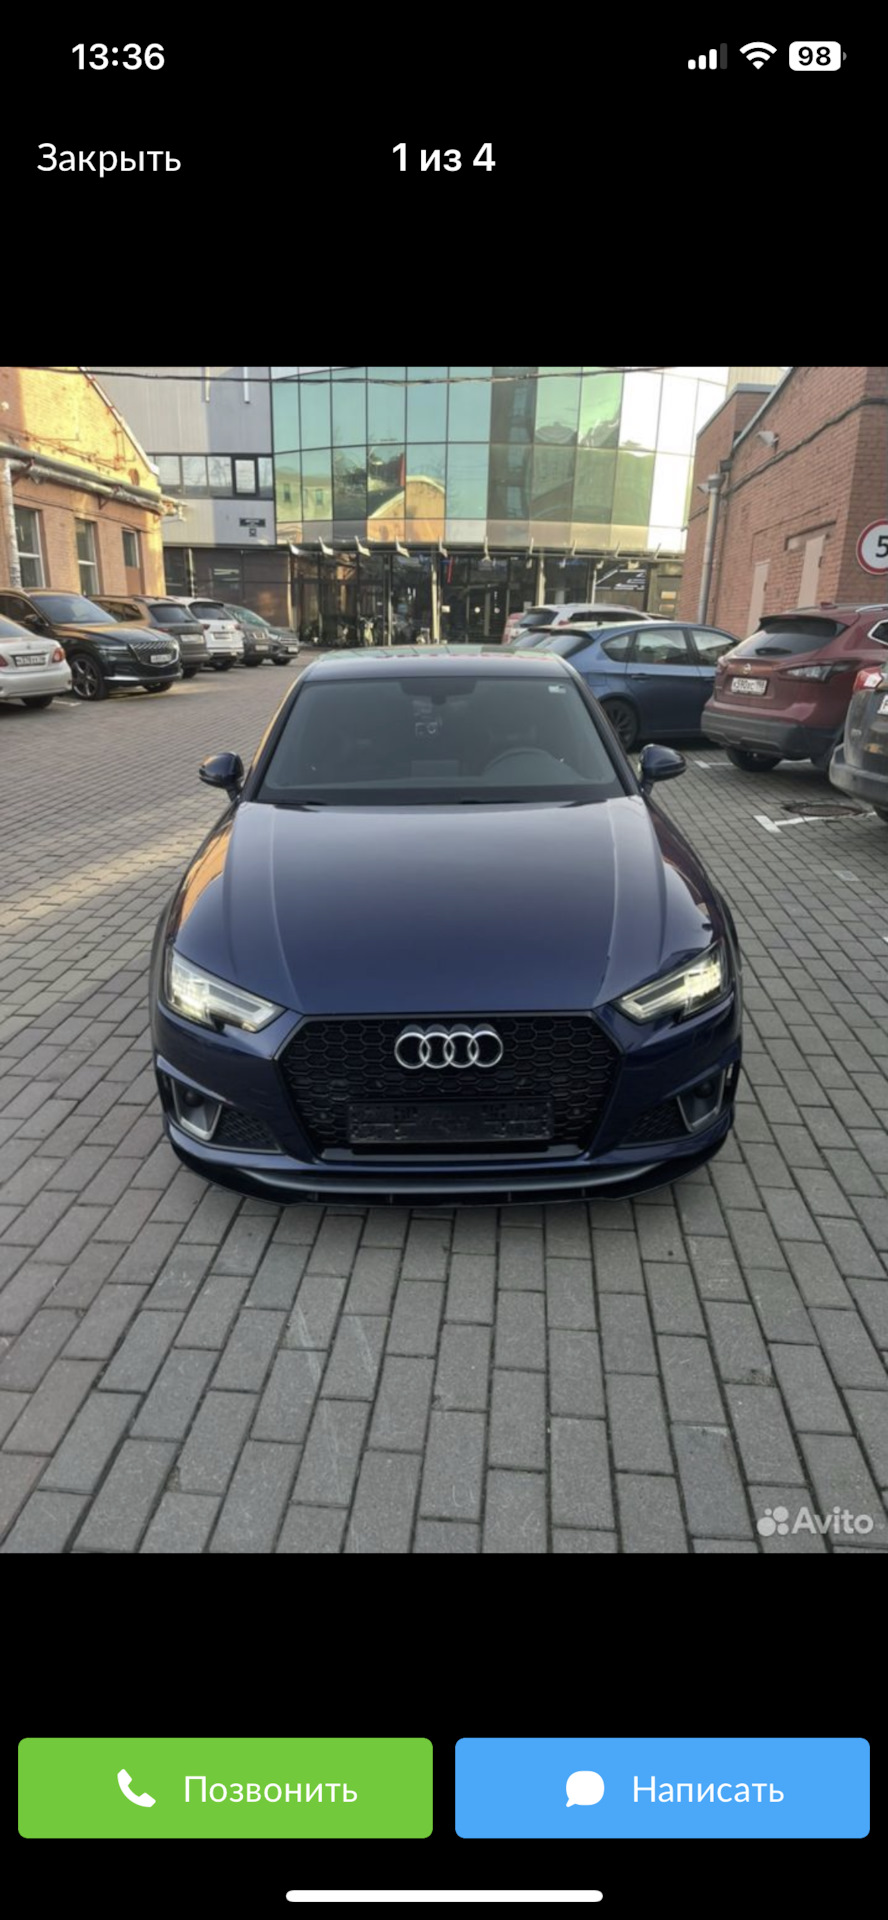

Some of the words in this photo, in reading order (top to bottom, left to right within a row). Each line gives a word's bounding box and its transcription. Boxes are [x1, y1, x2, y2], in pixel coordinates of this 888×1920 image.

[72, 43, 164, 70] 13:36
[799, 47, 830, 65] 98
[37, 143, 182, 178] Закрыть
[392, 143, 407, 171] 1
[420, 149, 462, 171] из
[472, 143, 496, 171] 4
[876, 534, 888, 558] 5
[184, 1776, 358, 1803] Позвонить
[633, 1776, 785, 1803] Написать
